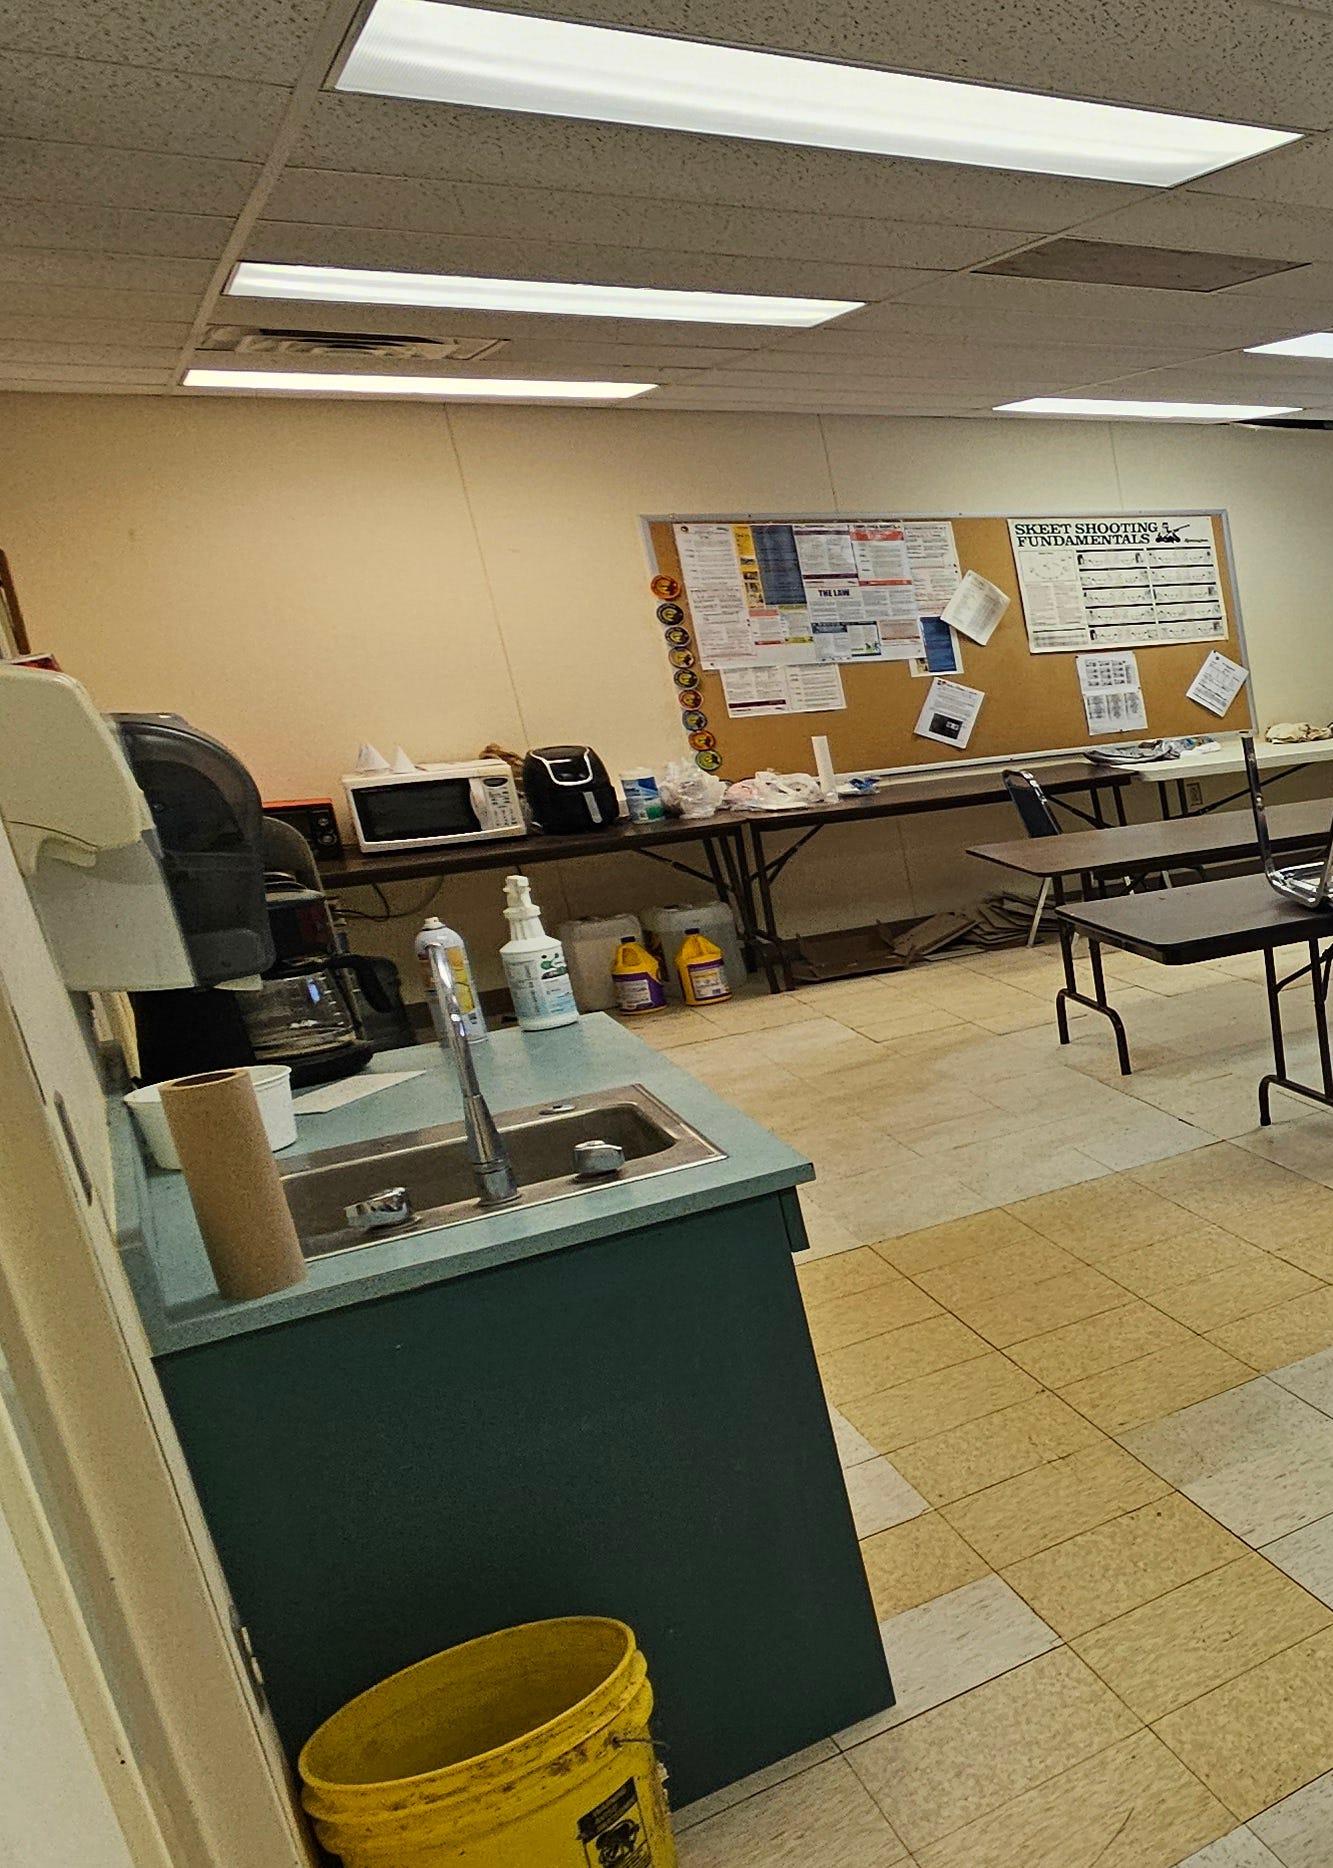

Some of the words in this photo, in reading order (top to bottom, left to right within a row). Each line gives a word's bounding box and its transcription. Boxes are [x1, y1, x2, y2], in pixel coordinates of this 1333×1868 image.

[1014, 523, 1072, 535] SKEET
[1075, 522, 1158, 534] SHOOTING
[1017, 534, 1150, 547] FUNDAMENTALS
[818, 589, 833, 597] THE
[833, 589, 850, 597] LAW
